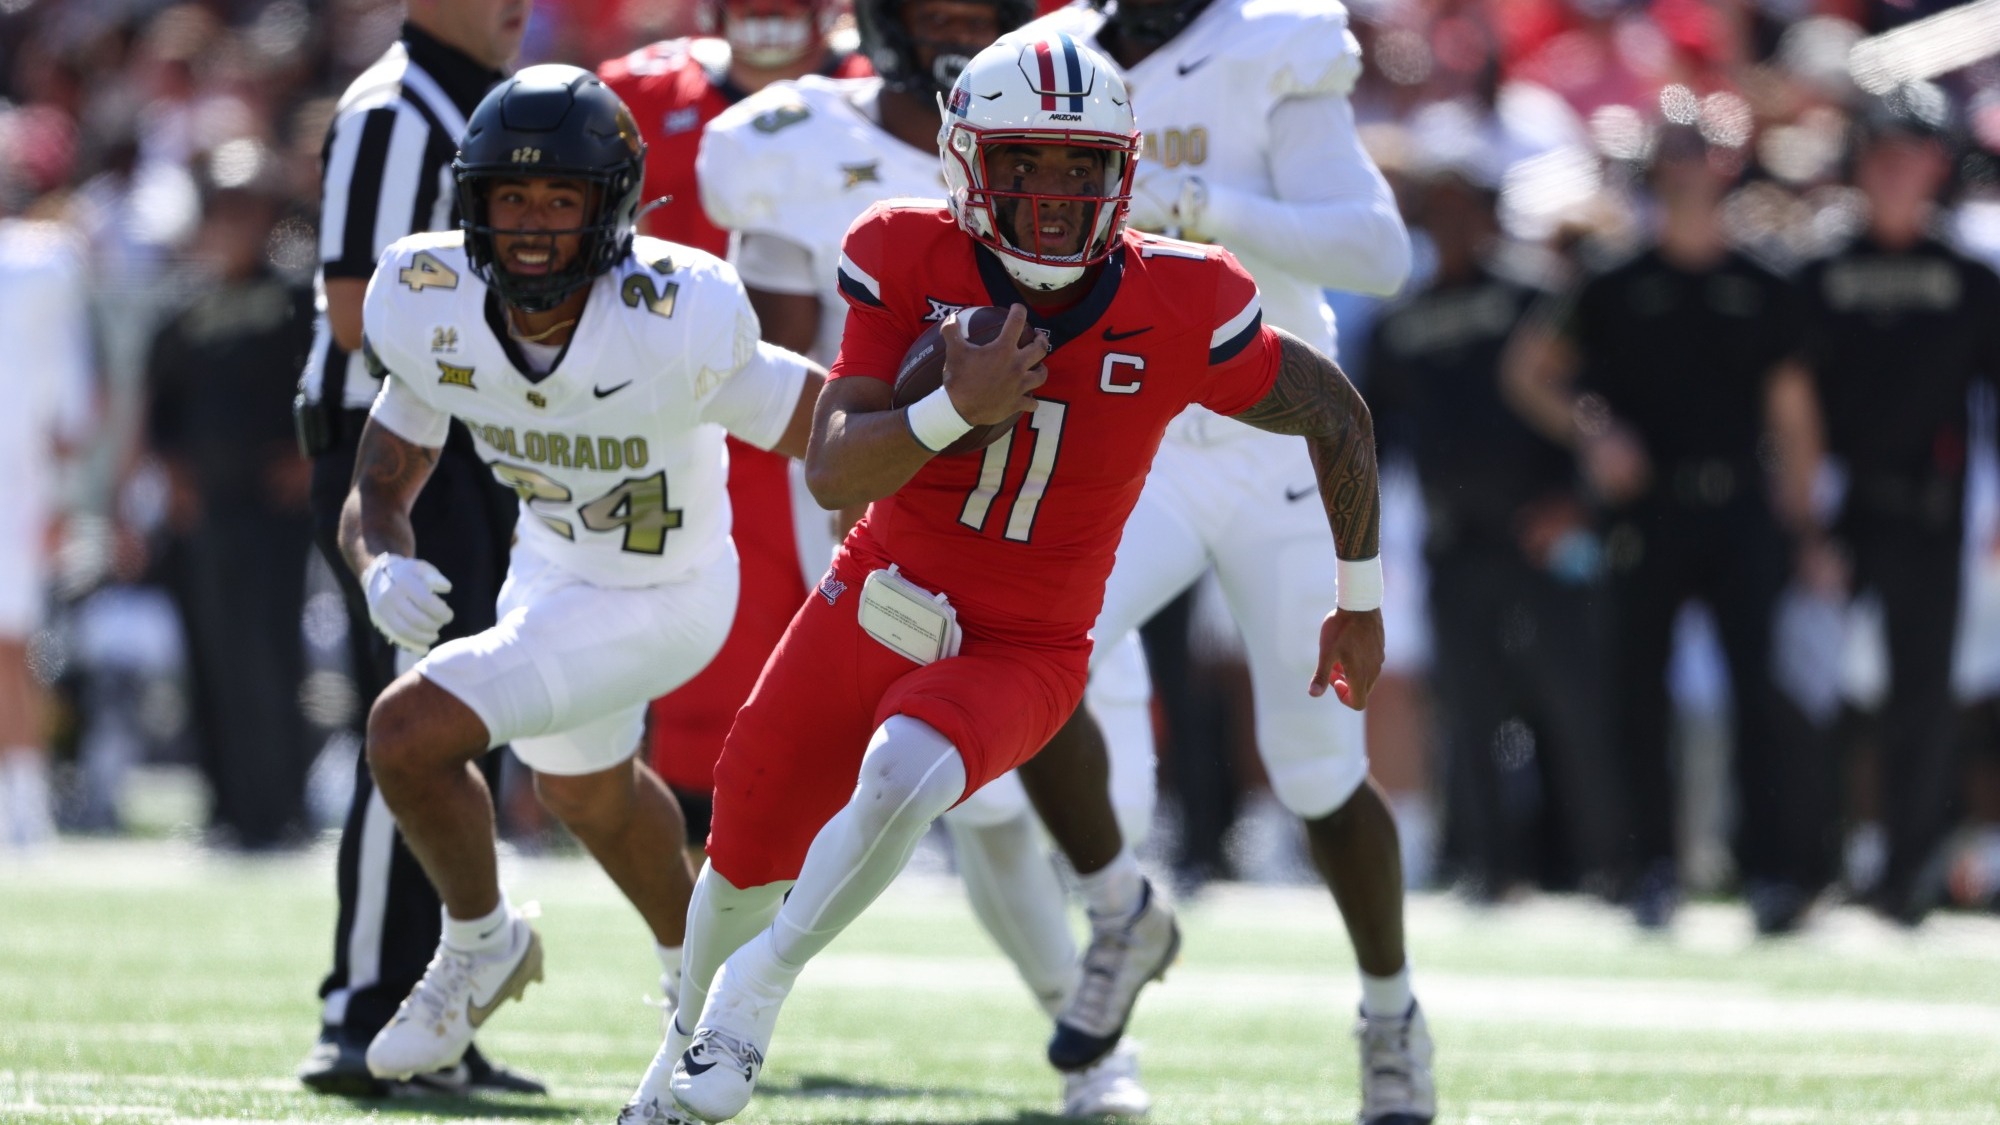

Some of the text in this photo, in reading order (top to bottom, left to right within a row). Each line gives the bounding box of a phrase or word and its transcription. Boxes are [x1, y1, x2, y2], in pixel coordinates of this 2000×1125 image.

[1048, 113, 1082, 122] ARIZONA
[399, 250, 459, 291] 4
[1099, 352, 1145, 394] C
[957, 395, 1069, 545] 11
